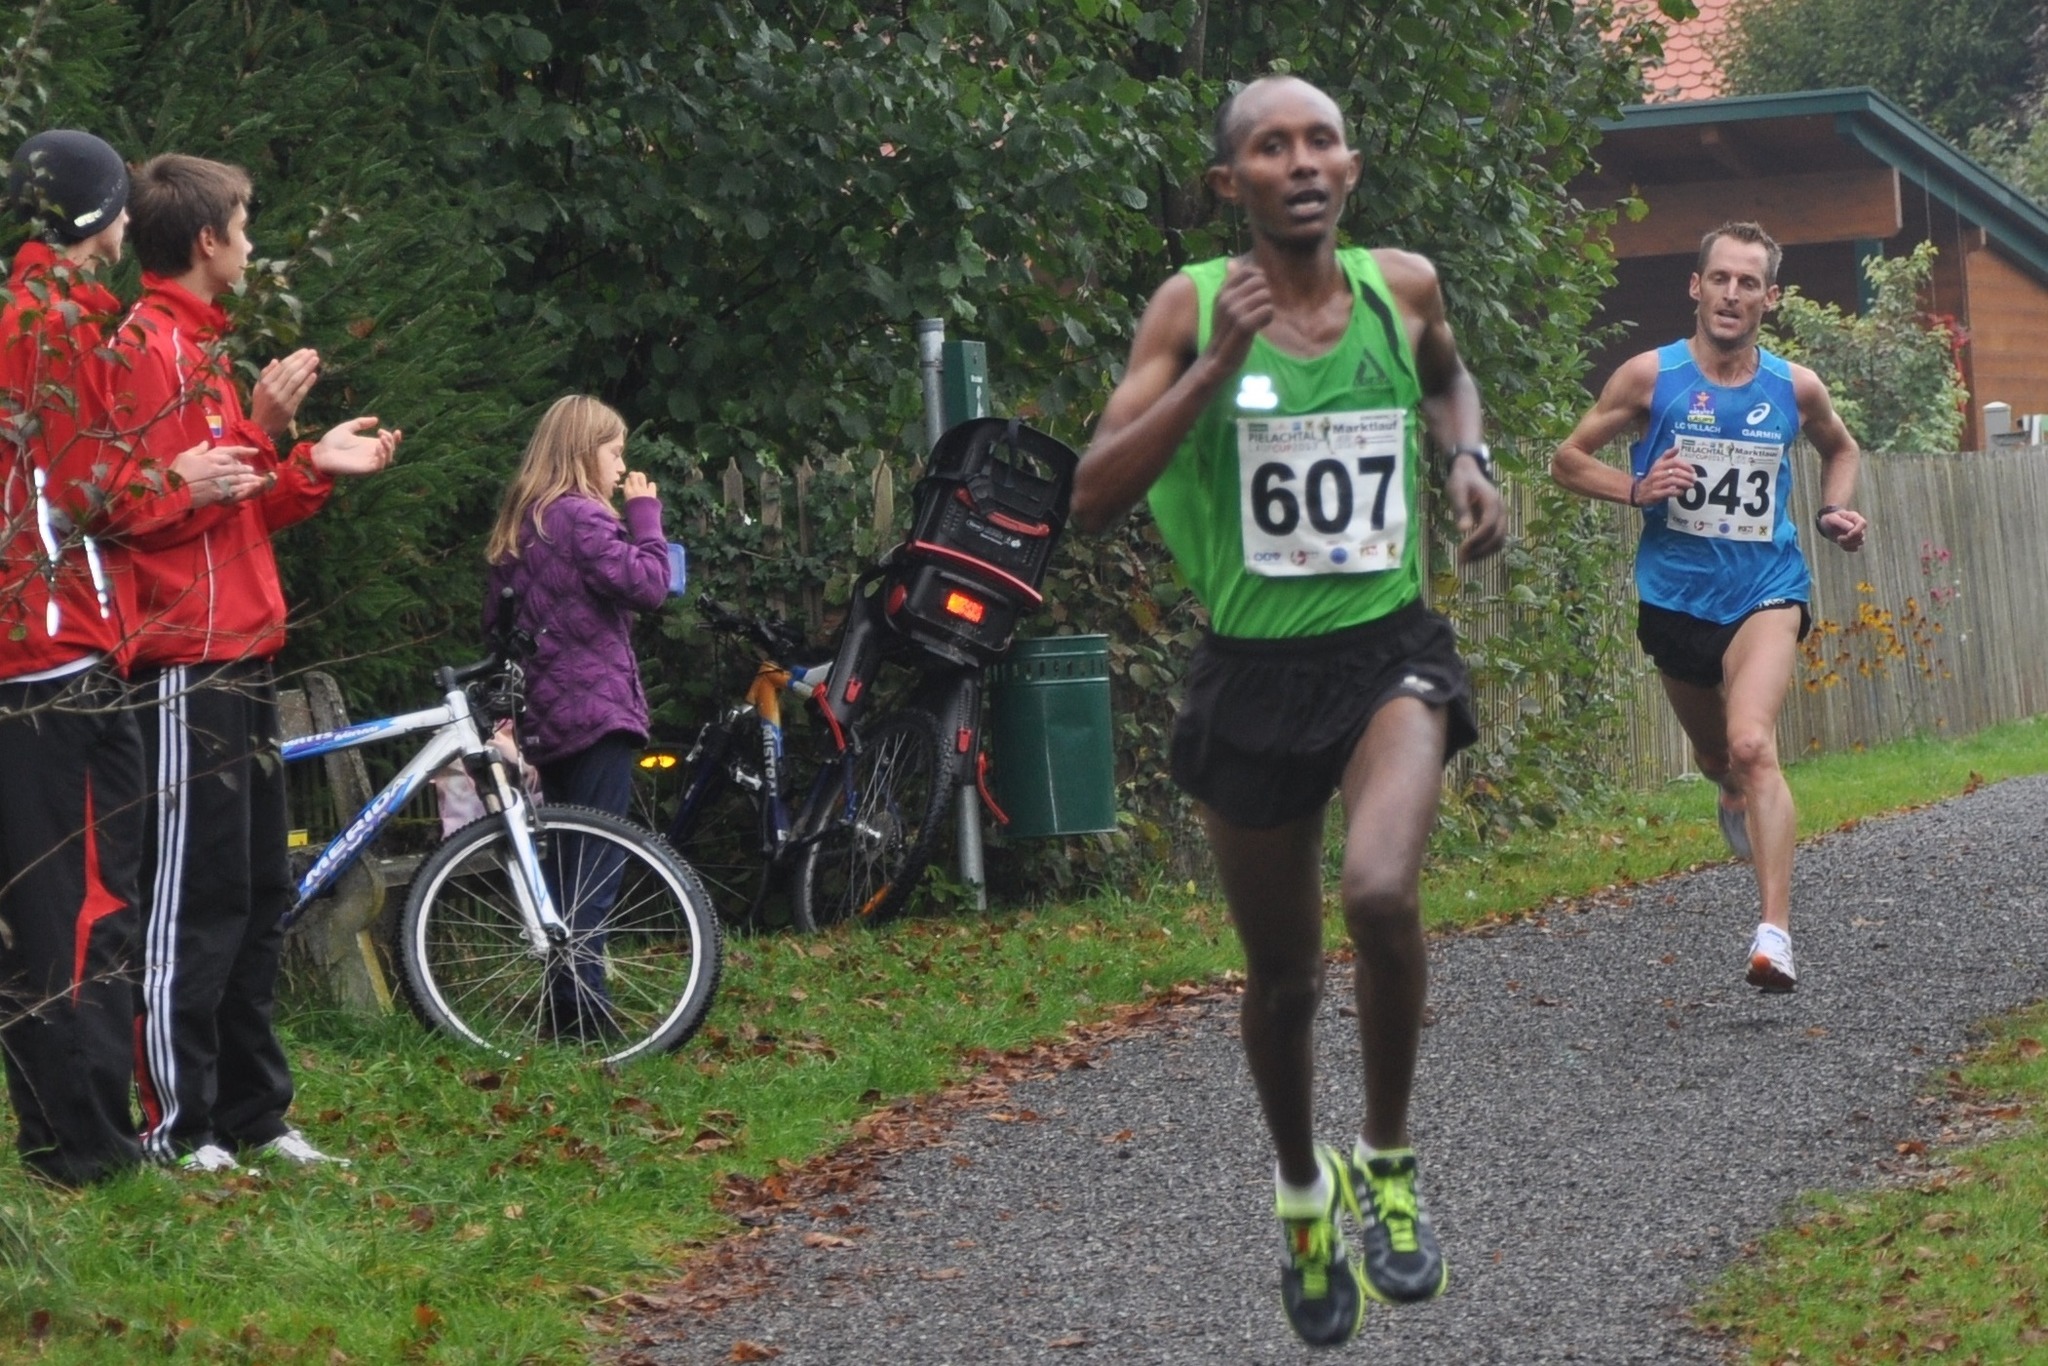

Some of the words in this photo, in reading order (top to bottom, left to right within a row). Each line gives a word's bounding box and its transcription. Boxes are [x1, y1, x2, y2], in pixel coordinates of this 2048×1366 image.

[1333, 421, 1397, 434] Marktlauf
[1674, 421, 1686, 430] LC
[1687, 422, 1721, 434] VILLACH
[1741, 428, 1782, 440] GARMIN
[1248, 431, 1316, 443] PIELACHTAL
[1680, 445, 1725, 456] PIELACHTAL
[1250, 455, 1396, 537] 607
[1675, 463, 1771, 518] 643
[304, 777, 409, 888] MERIDA
